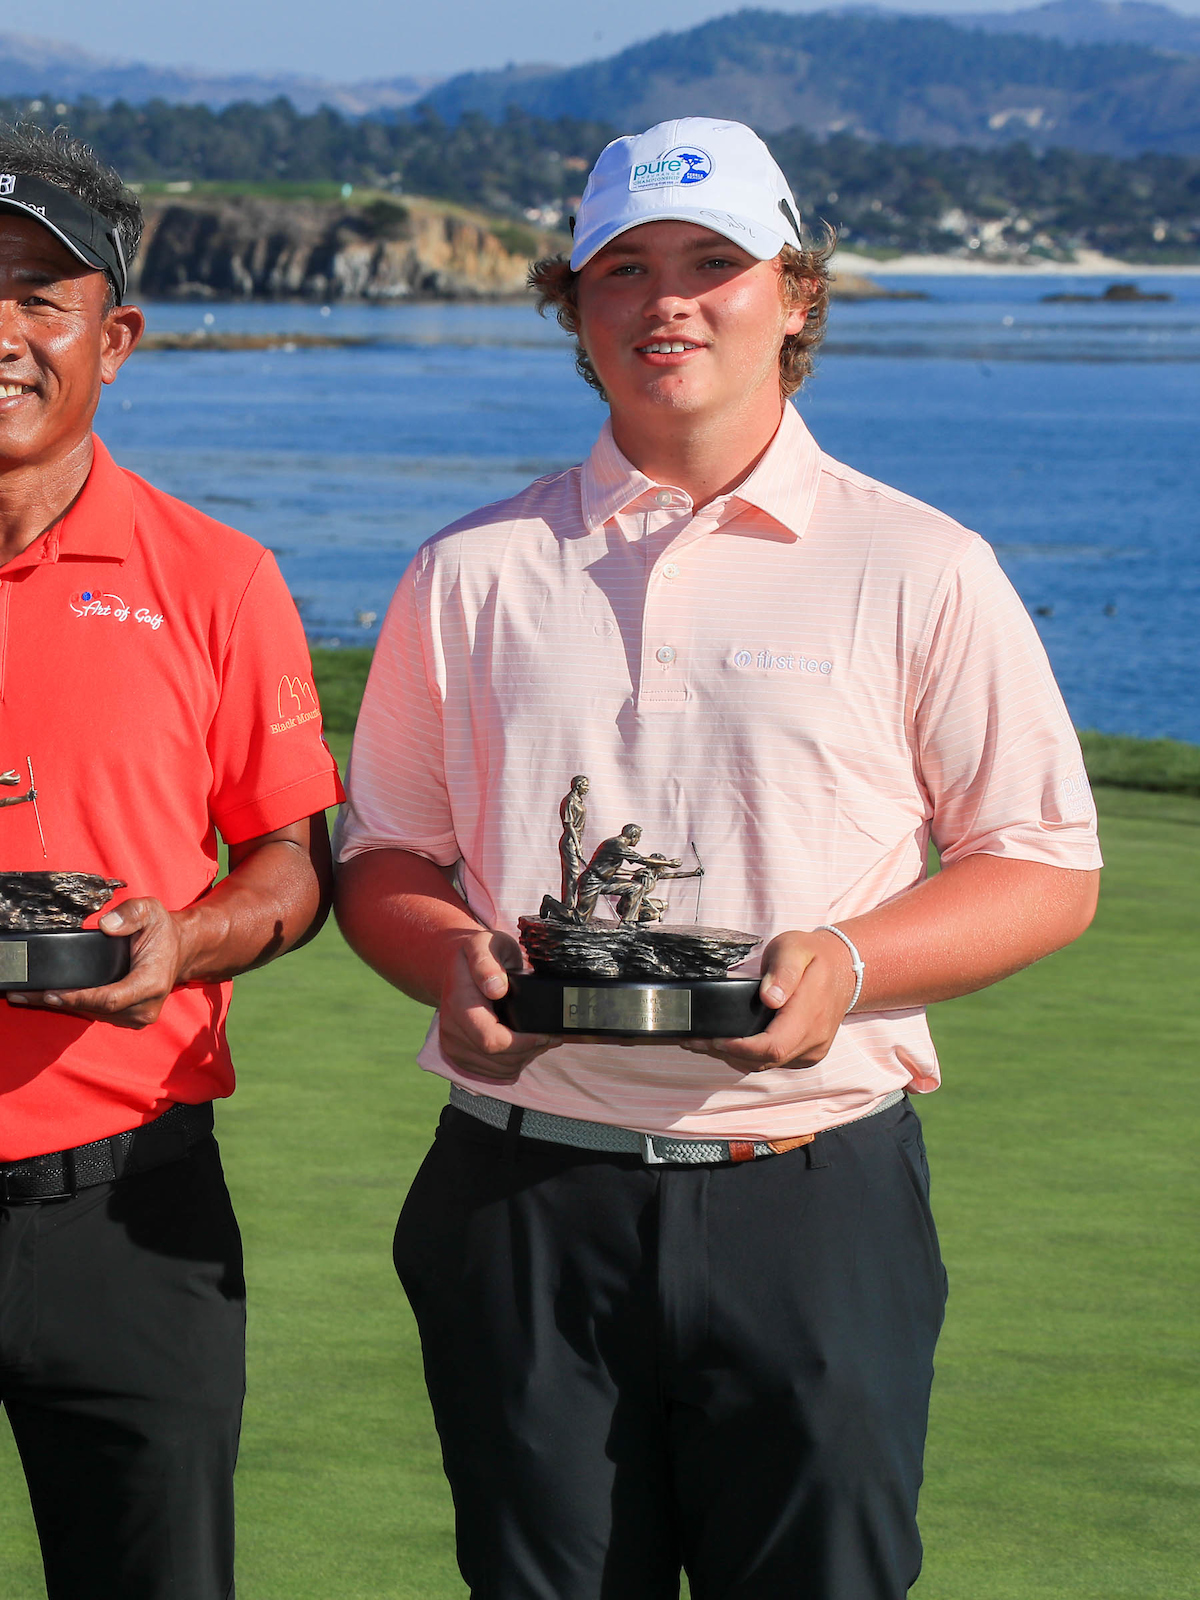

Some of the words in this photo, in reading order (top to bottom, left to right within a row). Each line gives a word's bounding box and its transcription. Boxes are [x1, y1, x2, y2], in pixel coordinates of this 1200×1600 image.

[634, 159, 681, 181] pure
[82, 600, 112, 617] Art
[114, 606, 131, 622] of
[135, 608, 165, 630] Golf
[757, 650, 794, 670] first
[799, 656, 832, 675] tee
[270, 718, 297, 735] Black
